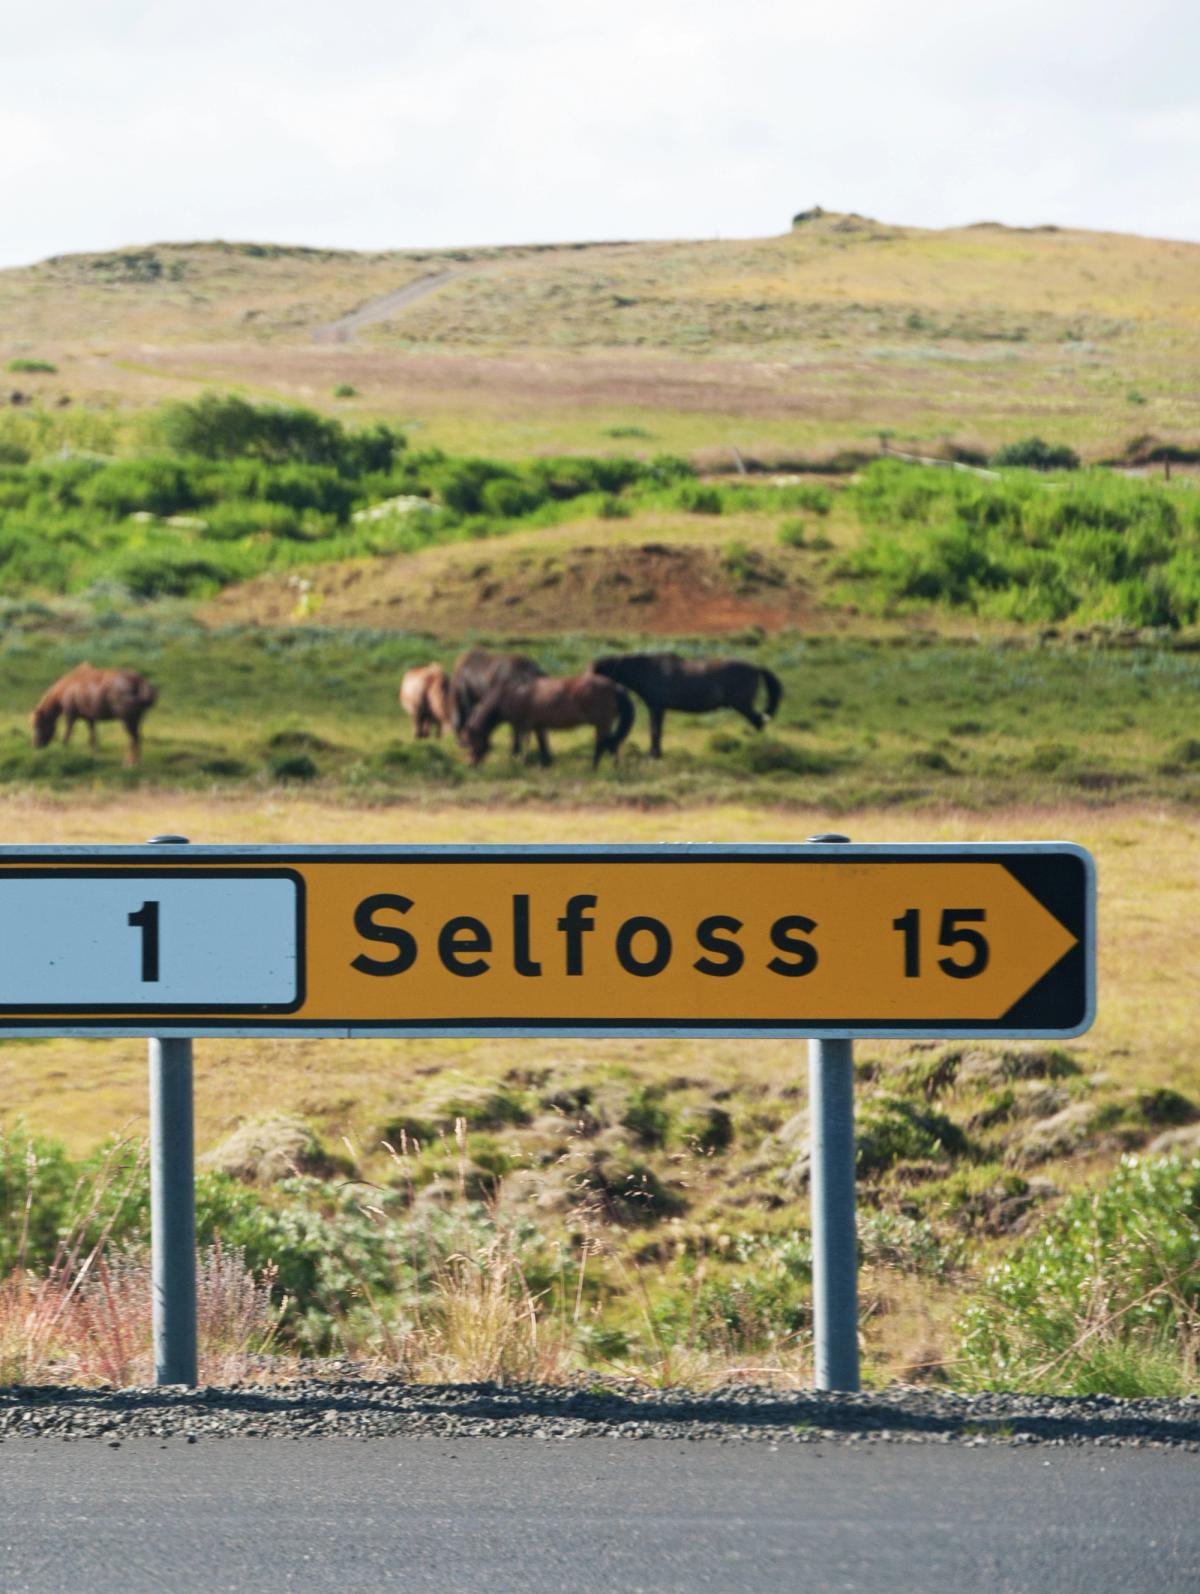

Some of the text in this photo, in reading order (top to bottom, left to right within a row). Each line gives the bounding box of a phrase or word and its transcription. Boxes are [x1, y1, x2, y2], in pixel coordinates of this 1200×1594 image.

[127, 893, 991, 982] 1 Selfoss 15
